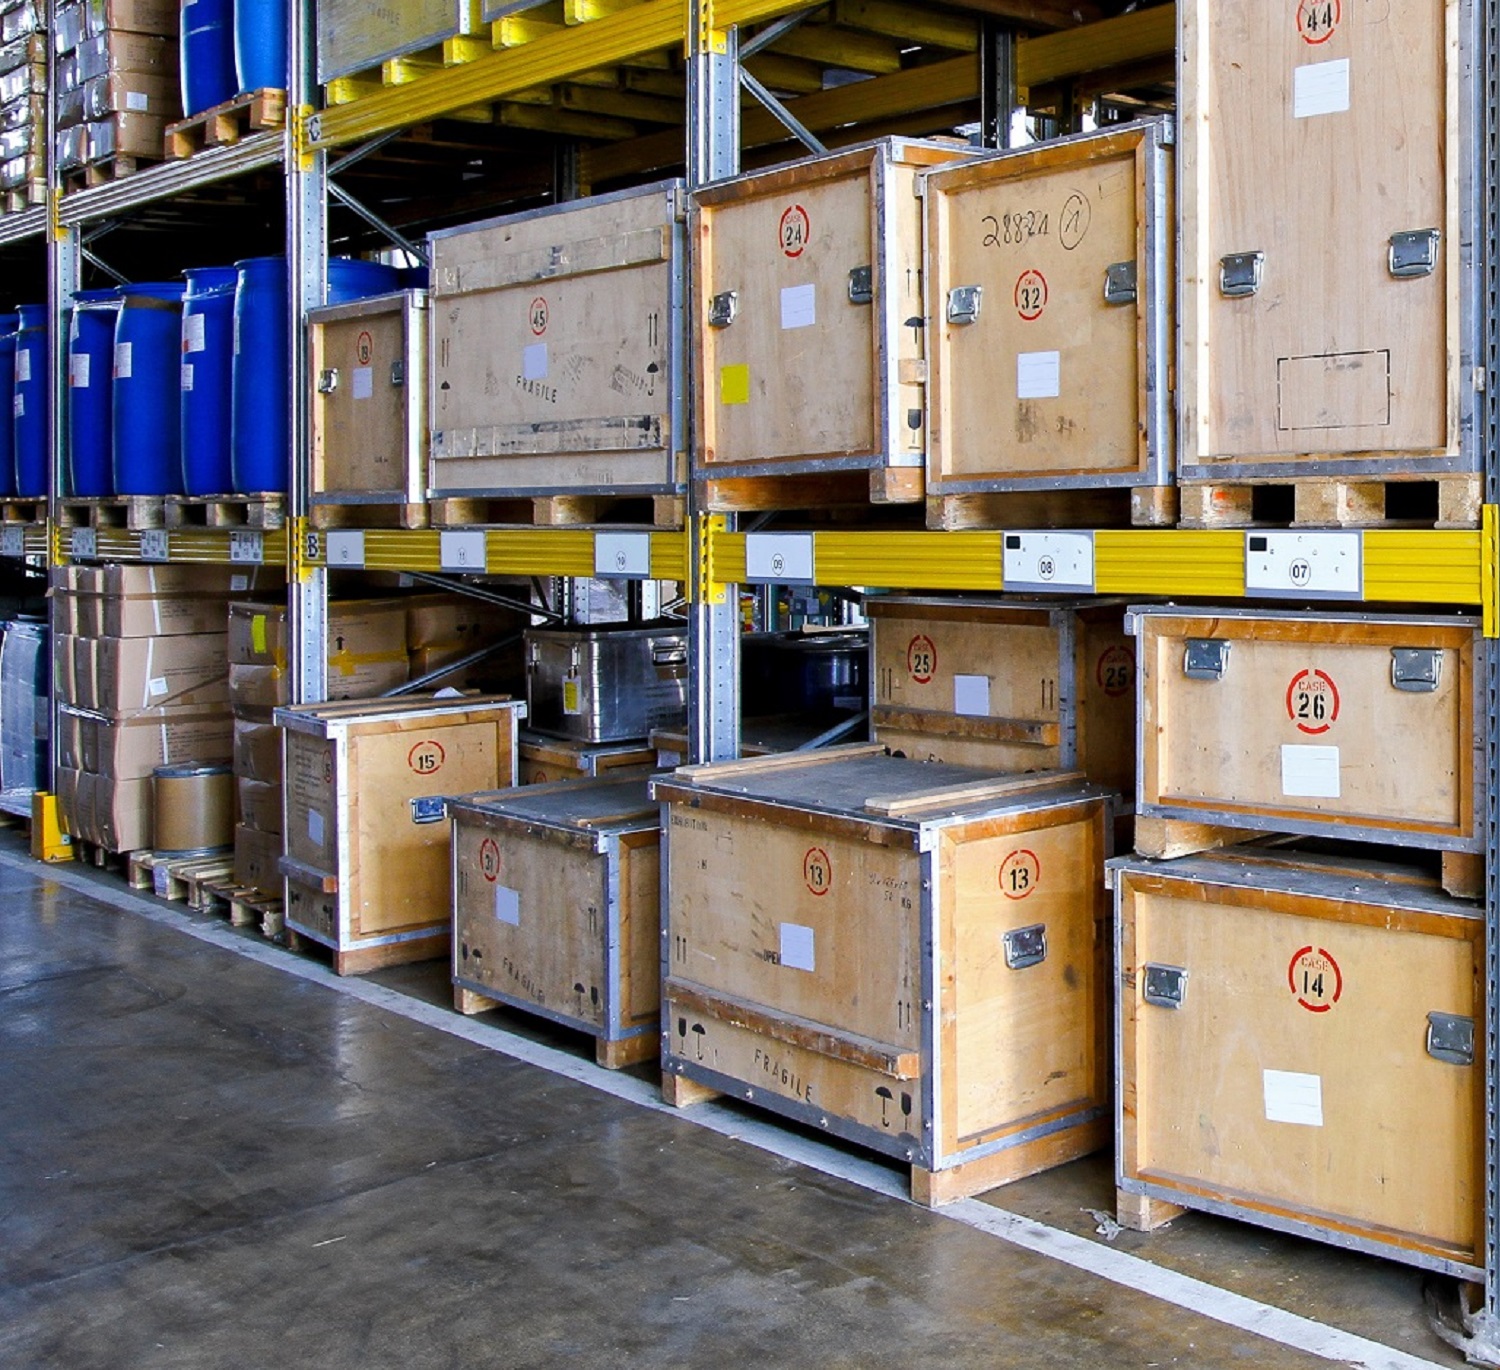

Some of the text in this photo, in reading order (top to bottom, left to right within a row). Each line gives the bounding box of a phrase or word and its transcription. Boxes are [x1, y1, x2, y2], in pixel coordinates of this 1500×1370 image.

[1307, 2, 1332, 31] 44
[786, 224, 801, 246] 24
[1022, 288, 1040, 311] 32
[533, 310, 546, 328] 45
[516, 375, 557, 403] FRAGILE
[307, 535, 319, 558] B
[773, 559, 784, 570] 09
[1040, 561, 1054, 574] 08
[1292, 564, 1308, 578] 07
[914, 653, 929, 674] 25
[1106, 666, 1128, 688] 25
[1299, 681, 1325, 691] CASE
[1298, 692, 1325, 720] 26
[418, 754, 434, 770] 15
[809, 864, 823, 886] 13
[1010, 868, 1029, 891] 13
[1301, 957, 1328, 971] CASE
[1303, 970, 1324, 998] 14
[754, 1048, 813, 1103] FRAGILE
